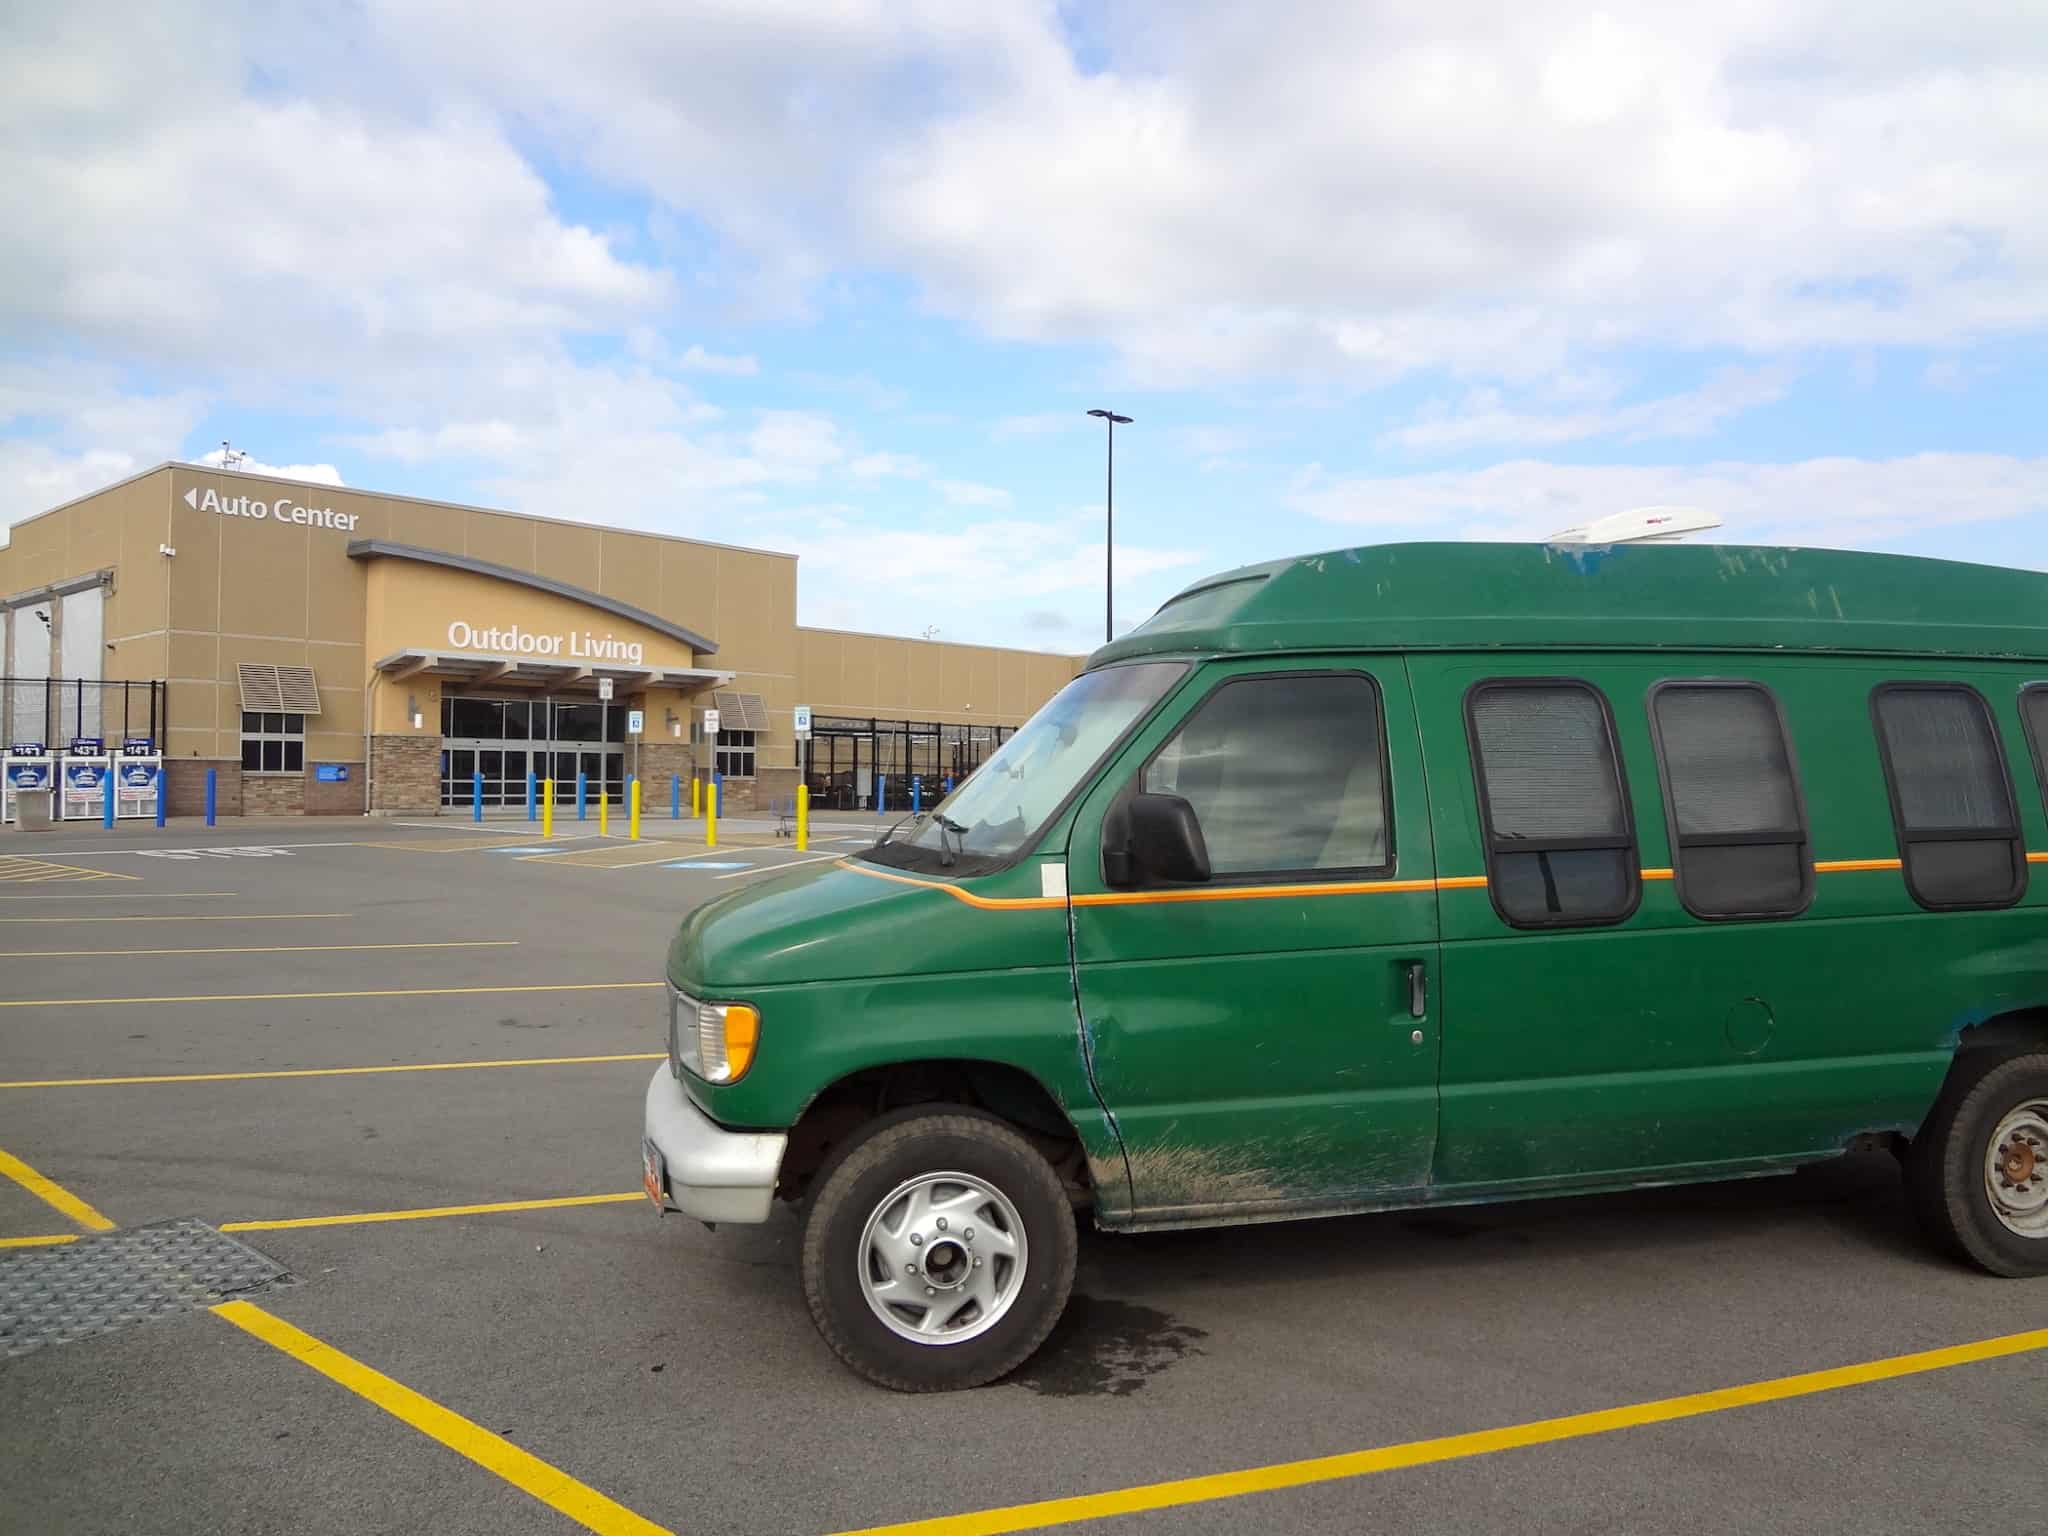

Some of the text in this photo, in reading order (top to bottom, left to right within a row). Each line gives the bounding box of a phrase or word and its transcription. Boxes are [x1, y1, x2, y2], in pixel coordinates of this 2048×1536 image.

[200, 488, 359, 531] Auto Center
[448, 621, 642, 665] Outdoor Living
